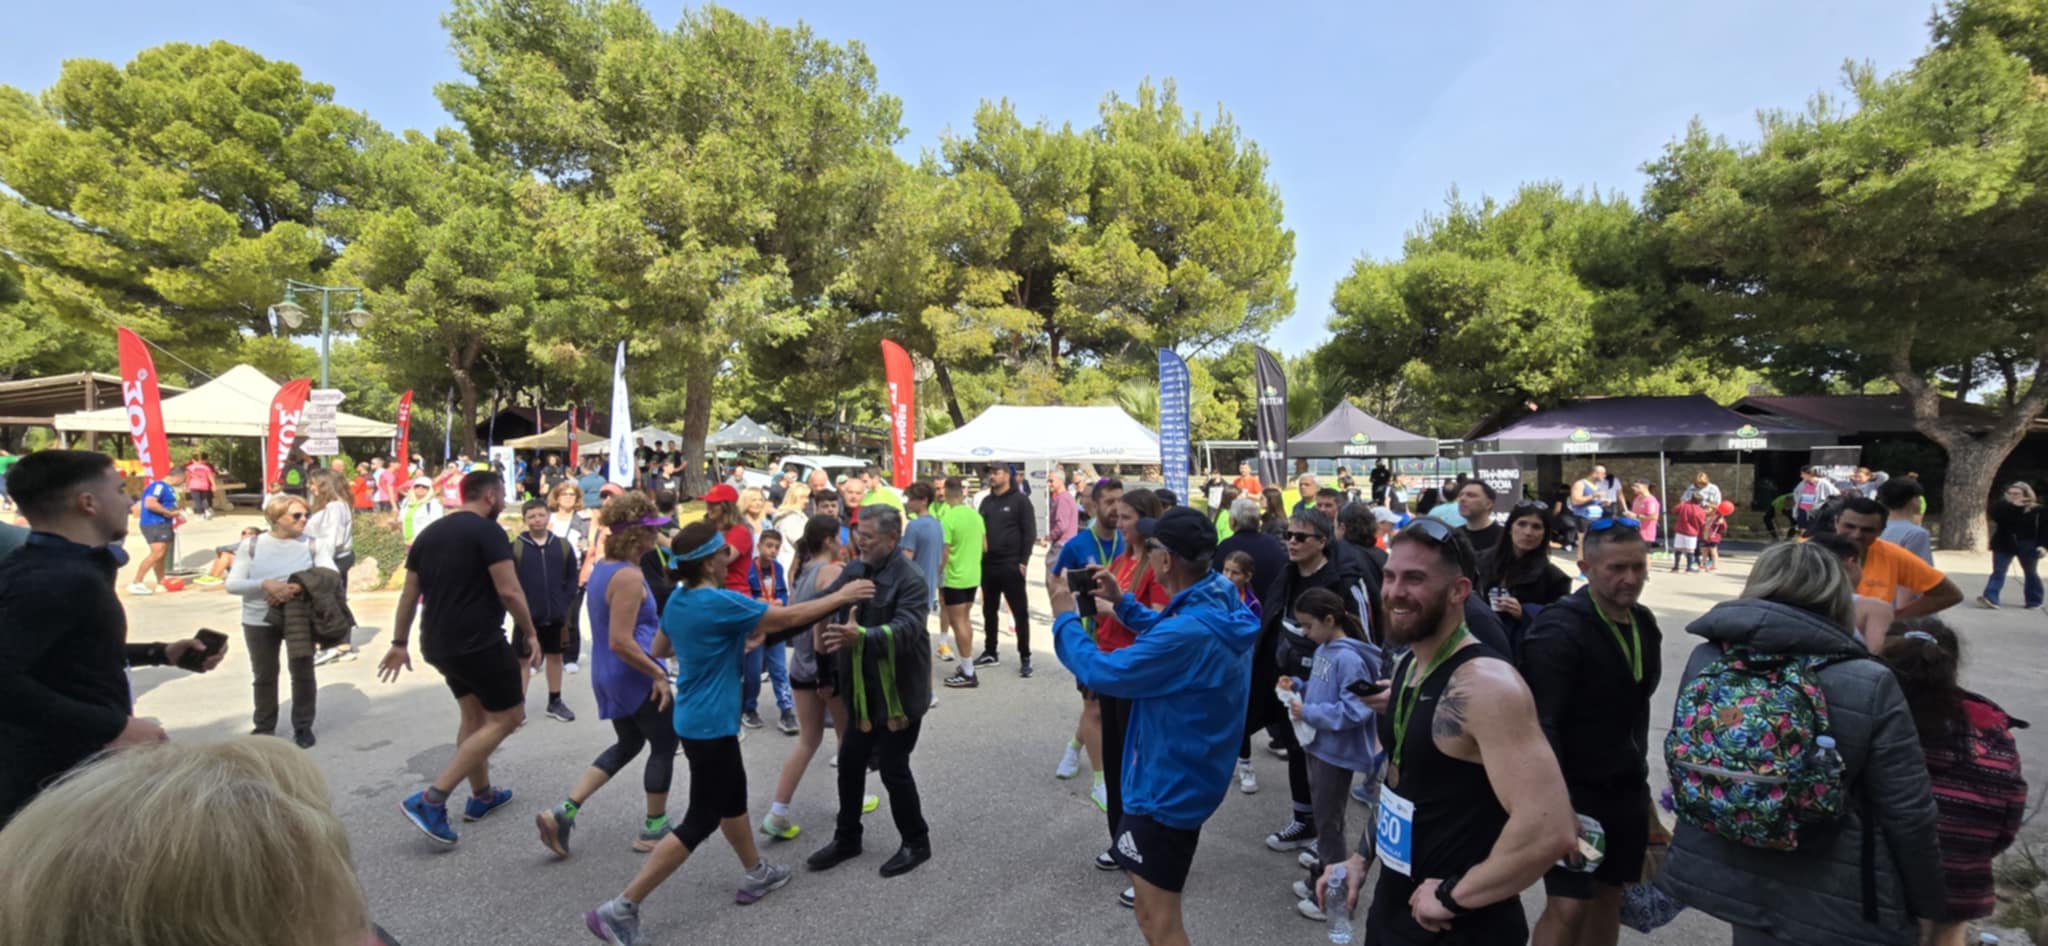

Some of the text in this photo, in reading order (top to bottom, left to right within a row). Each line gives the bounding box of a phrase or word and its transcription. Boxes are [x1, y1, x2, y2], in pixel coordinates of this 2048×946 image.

[1563, 442, 1598, 453] PROTEIN
[1729, 438, 1767, 449] PROTEIN
[1344, 445, 1377, 455] PROTEIN
[1378, 804, 1400, 844] 50
